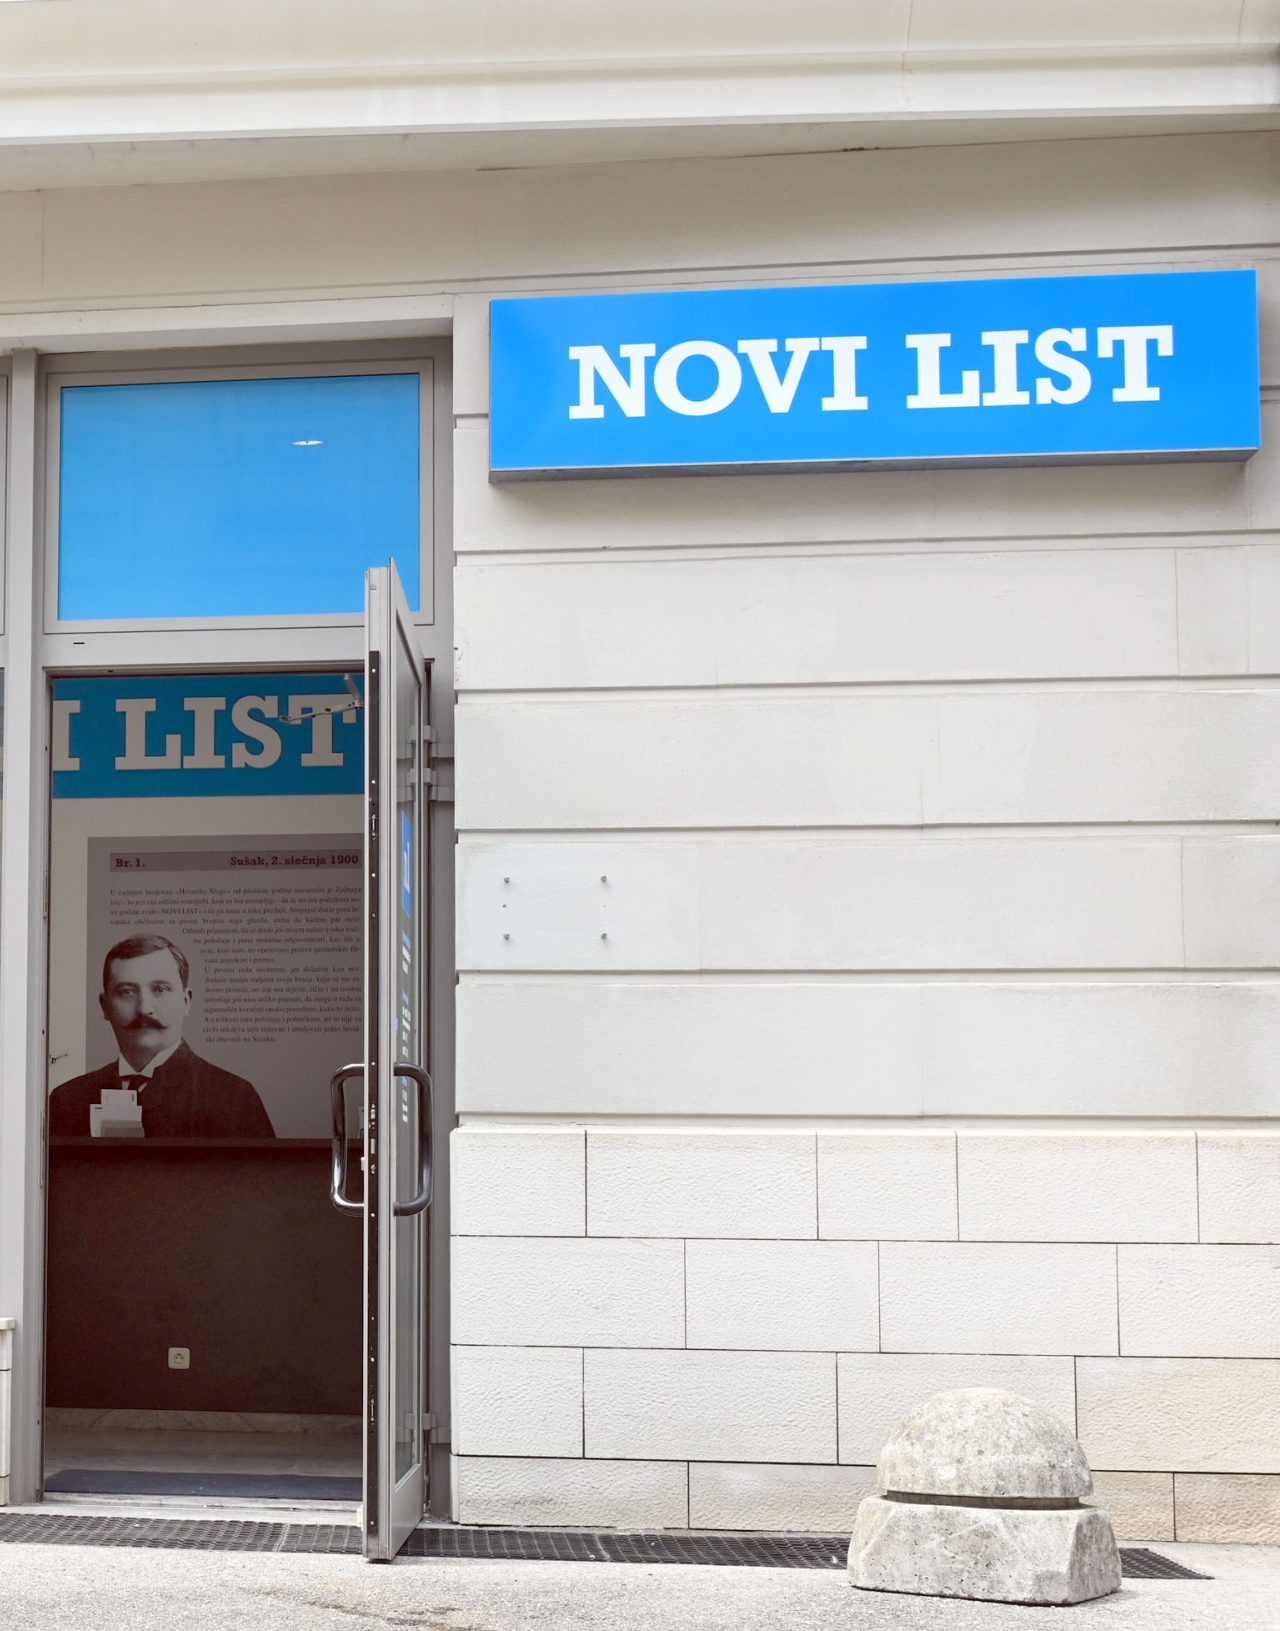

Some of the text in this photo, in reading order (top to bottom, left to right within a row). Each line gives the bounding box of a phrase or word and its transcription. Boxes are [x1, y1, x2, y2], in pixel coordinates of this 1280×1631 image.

[568, 324, 1174, 420] NOVI LIST
[115, 694, 358, 770] LIST
[115, 858, 133, 868] Br.
[271, 856, 282, 867] 2.
[331, 855, 359, 866] 1900
